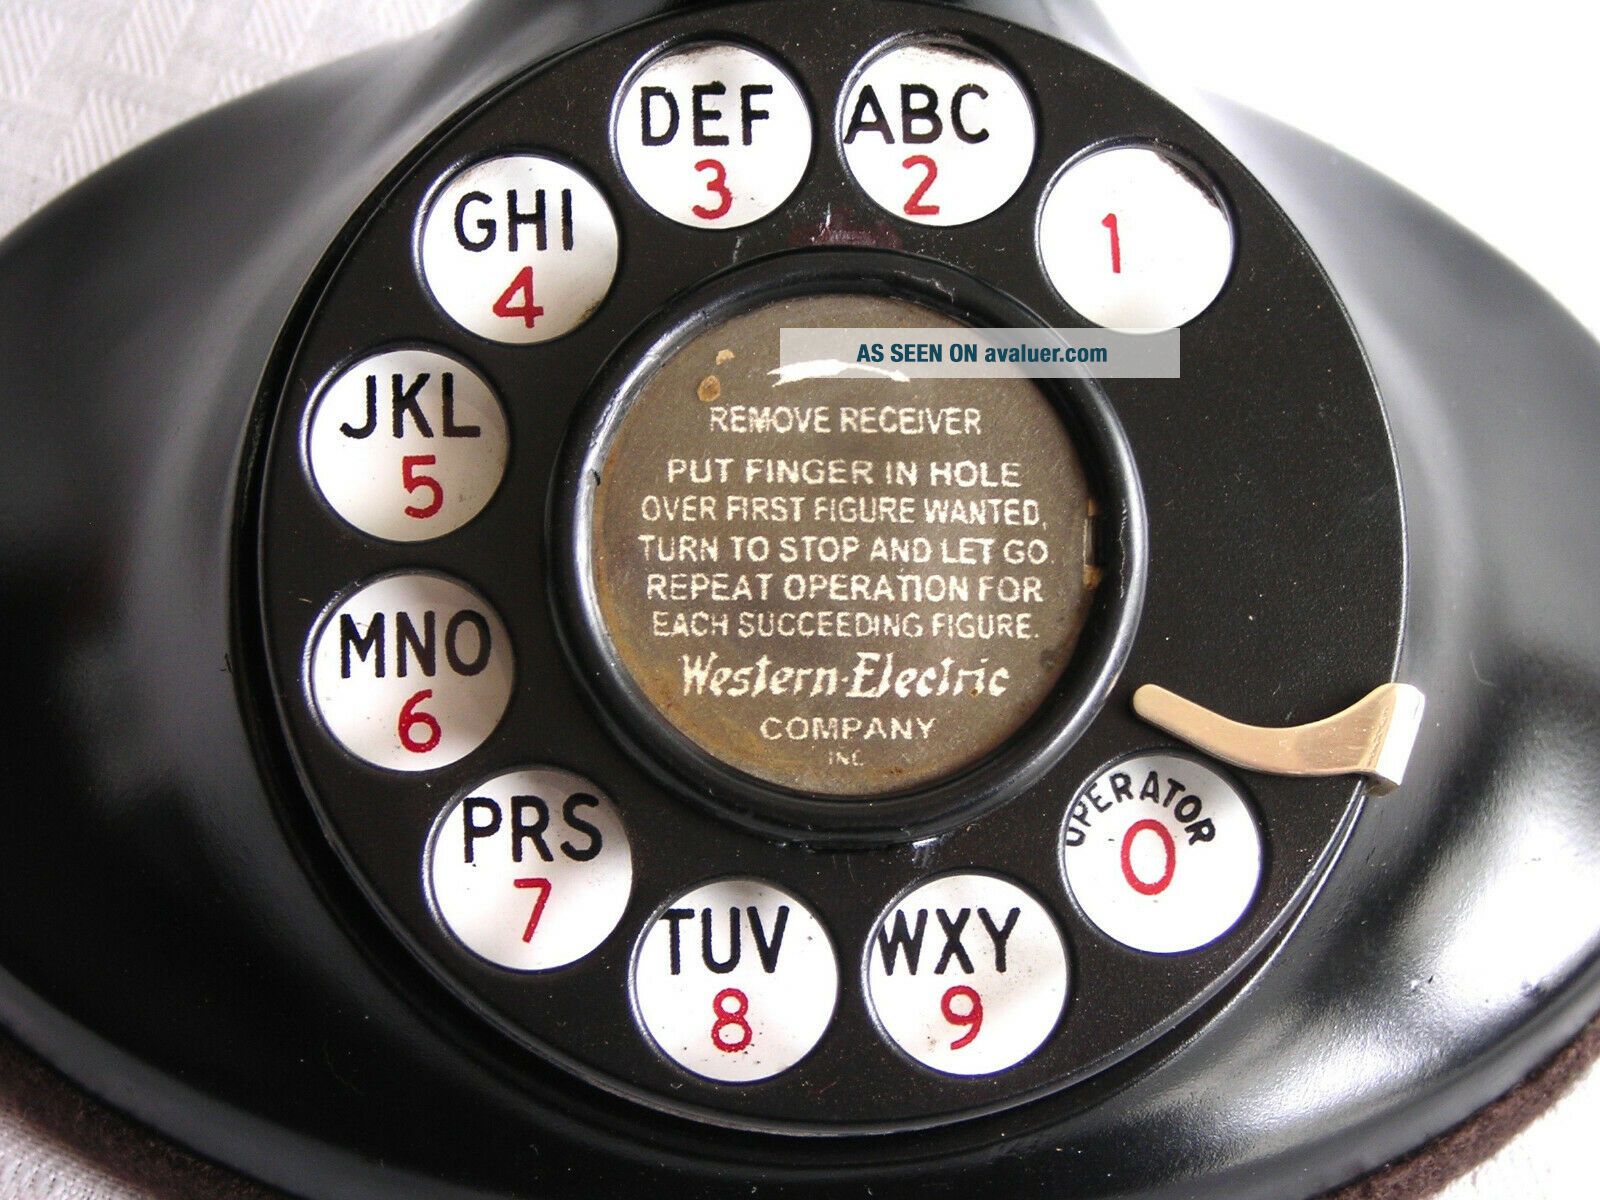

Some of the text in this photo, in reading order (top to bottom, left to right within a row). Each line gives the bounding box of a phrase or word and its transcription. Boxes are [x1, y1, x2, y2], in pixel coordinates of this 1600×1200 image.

[640, 81, 773, 146] DEF
[843, 84, 989, 144] ABC
[692, 159, 732, 219] 3
[902, 155, 940, 216] 2
[454, 189, 574, 251] GHI
[1101, 213, 1121, 273] 1
[493, 266, 544, 328] 4
[340, 372, 481, 439] JKL
[710, 405, 981, 435] REMOVE RECEIVER
[402, 455, 444, 519] 5
[667, 458, 1022, 487] PUT FINGER IN HOLE
[641, 495, 717, 522] OVER
[726, 496, 805, 522] FIRST
[814, 496, 916, 523] FIGURE
[638, 534, 719, 562] TURN
[729, 536, 770, 562] TO
[779, 536, 860, 562] STOP
[870, 537, 933, 563] AND
[940, 537, 996, 564] LET
[646, 573, 1044, 602] REPEAT OPERATION FOR
[340, 609, 492, 679] MNO
[652, 610, 1040, 639] EACH SUCCEEDING FIGURE.
[398, 688, 442, 753] 6
[759, 716, 937, 740] COMPANY
[462, 792, 603, 863] PRS
[1064, 770, 1216, 847] OPERATOR
[1120, 818, 1176, 895] 0
[513, 877, 552, 943] 7
[660, 905, 790, 975] TUV
[877, 907, 1021, 976] WXY
[711, 988, 753, 1053] 8
[940, 985, 984, 1050] 9
